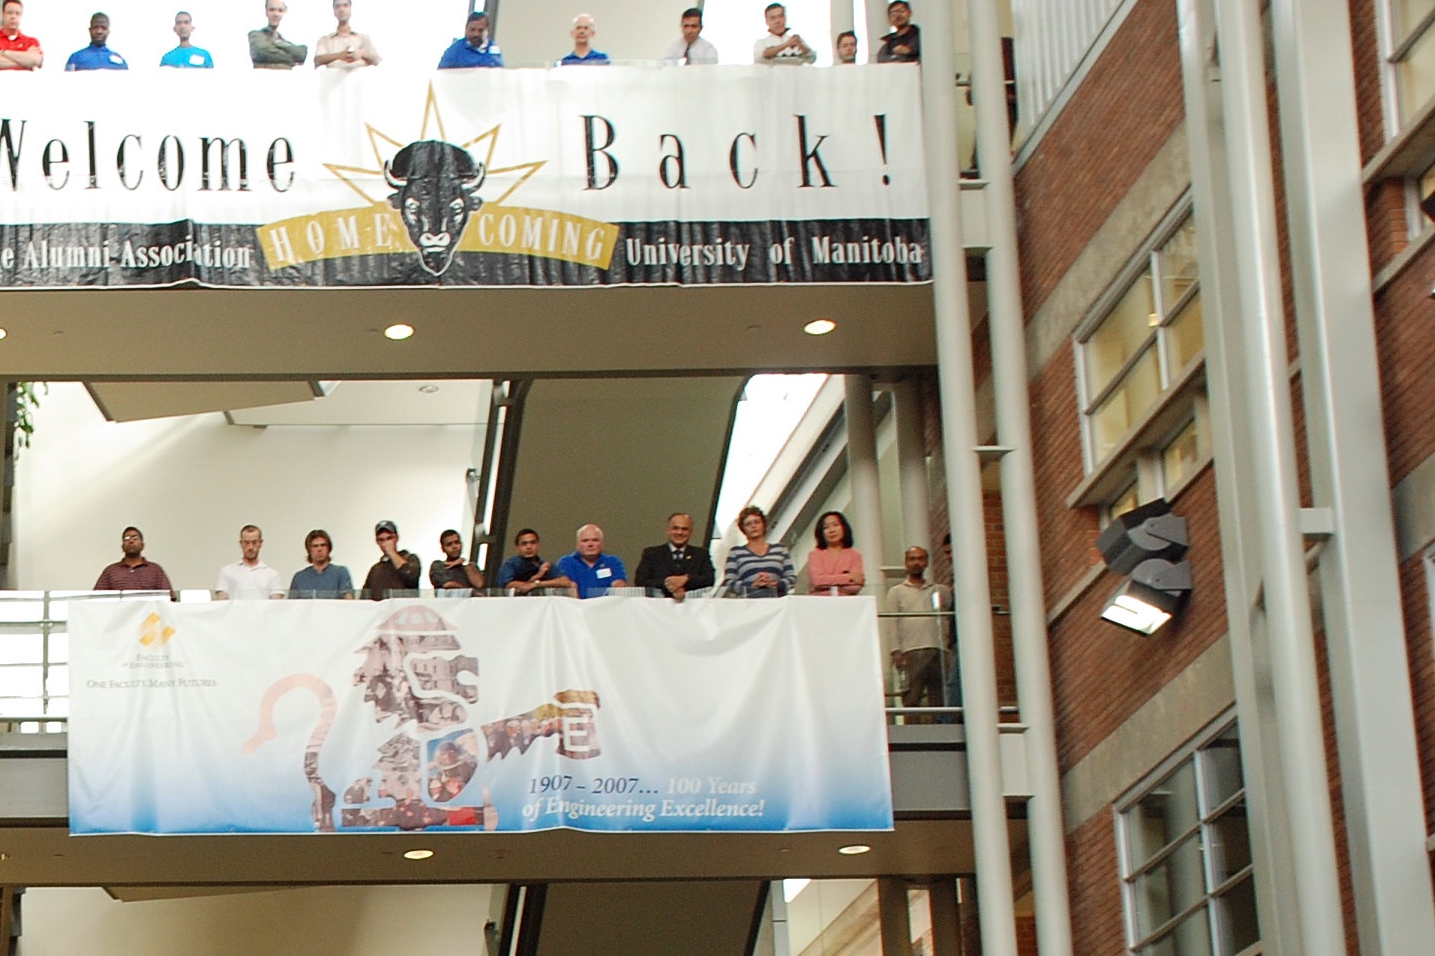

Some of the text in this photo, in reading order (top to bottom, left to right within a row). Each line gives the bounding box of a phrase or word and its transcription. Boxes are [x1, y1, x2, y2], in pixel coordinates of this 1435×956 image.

[579, 113, 891, 191] Back!
[23, 240, 110, 268] Alumni
[119, 234, 251, 268] Association
[269, 212, 605, 263] HOME COMING
[625, 235, 923, 271] University of Manitoba
[529, 775, 572, 794] 1907
[667, 777, 701, 794] 100
[707, 776, 757, 795] Years
[522, 797, 765, 822] of Engineering Excellence!
